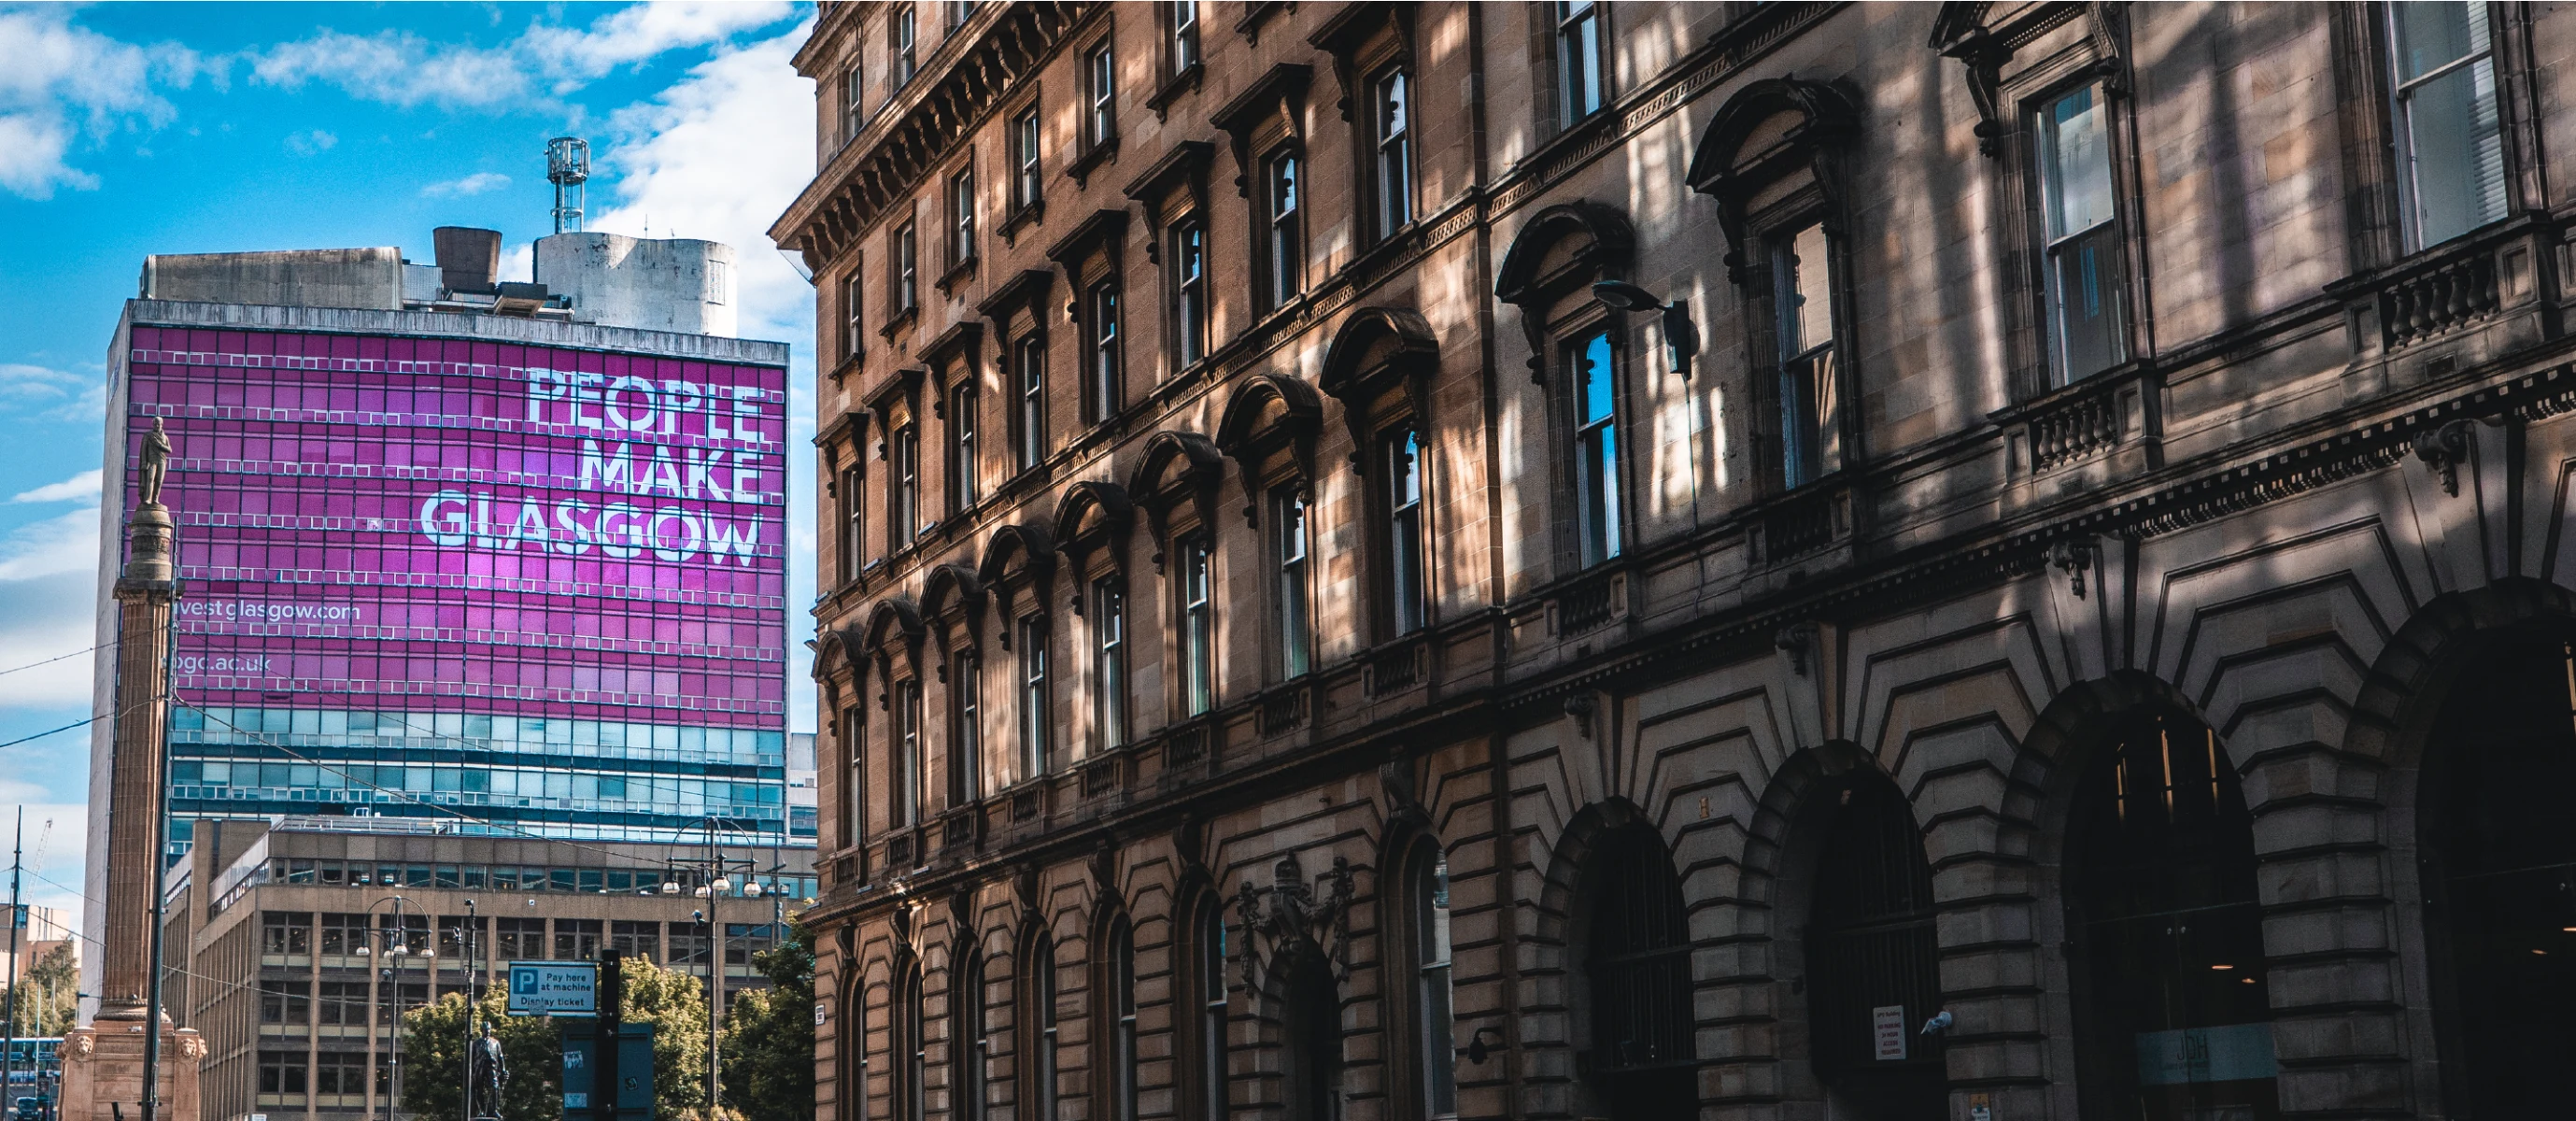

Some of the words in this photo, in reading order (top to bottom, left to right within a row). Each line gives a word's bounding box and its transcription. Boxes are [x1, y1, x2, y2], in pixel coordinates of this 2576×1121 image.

[528, 367, 765, 442] PEOPLE
[580, 439, 765, 504] MAKE
[419, 489, 764, 567] GLASGOW
[546, 973, 563, 983] Pay
[566, 973, 587, 982] here
[558, 998, 585, 1006] ticket
